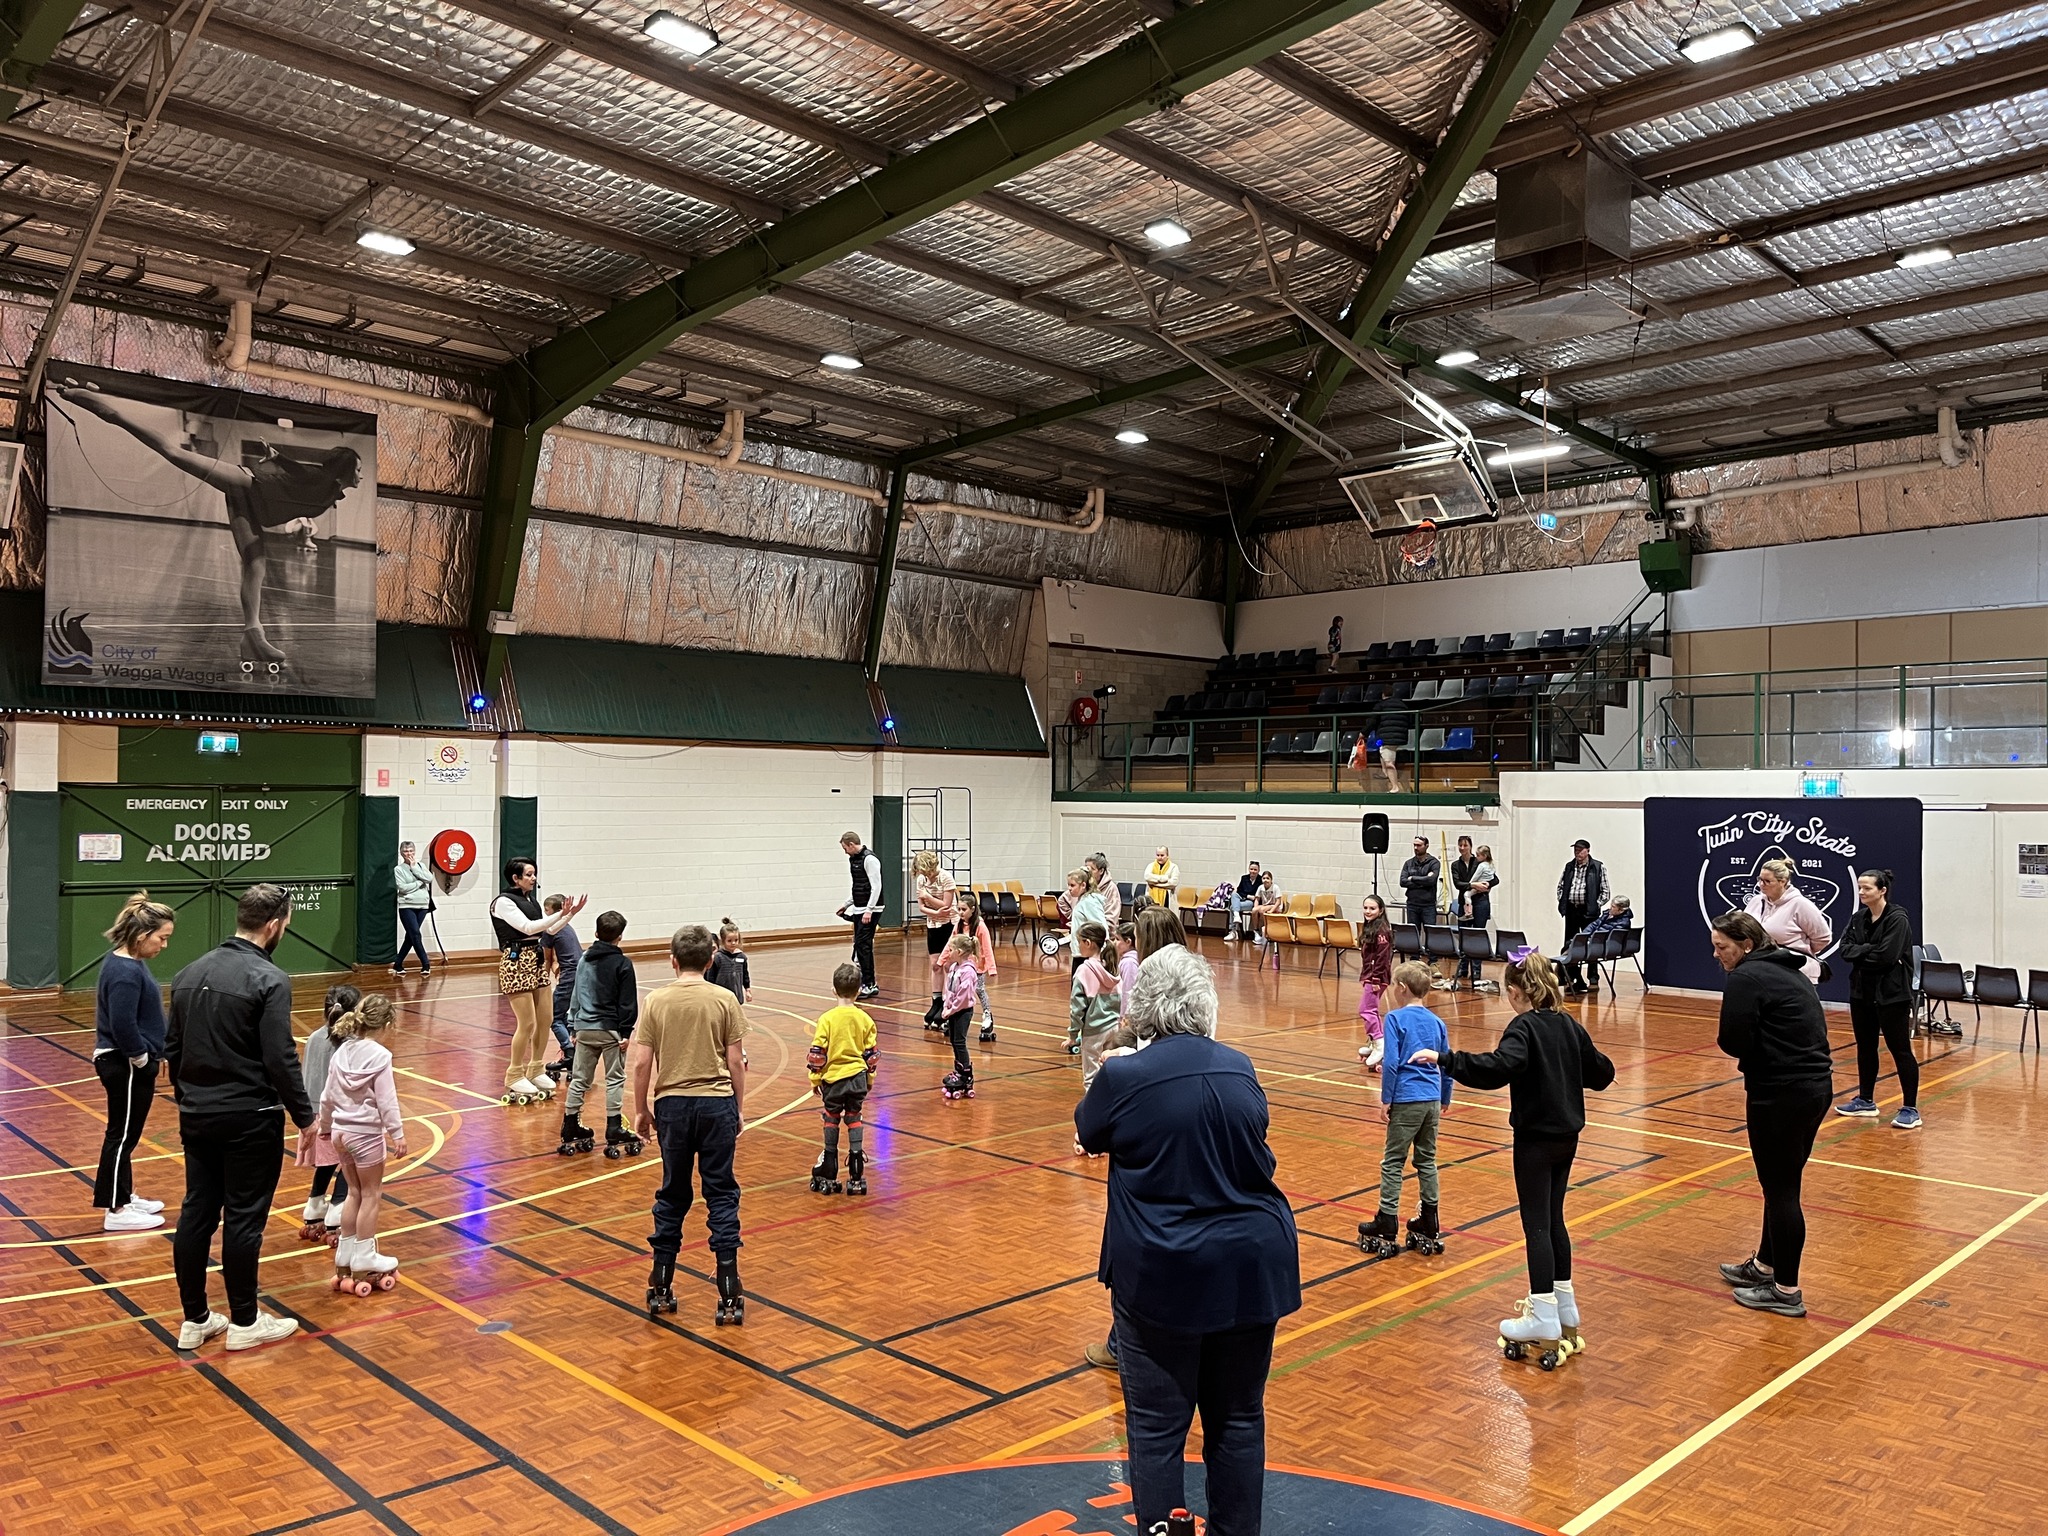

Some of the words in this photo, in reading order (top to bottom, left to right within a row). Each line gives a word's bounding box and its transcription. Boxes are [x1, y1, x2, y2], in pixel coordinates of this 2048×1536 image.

[102, 645, 134, 661] City
[141, 647, 157, 659] of
[102, 664, 161, 681] Wagga
[170, 666, 226, 684] Wagga
[126, 799, 208, 810] EMERGENCY
[221, 800, 250, 810] EXIT
[254, 800, 289, 810] ONLY
[174, 823, 251, 841] DOORS
[1698, 814, 1743, 854] Twin
[1741, 811, 1795, 843] City
[1795, 817, 1856, 857] Skate
[145, 843, 271, 862] ALARMED
[1730, 857, 1748, 865] EST.
[1801, 859, 1822, 868] 2021
[324, 882, 338, 890] BE
[308, 892, 321, 901] AT
